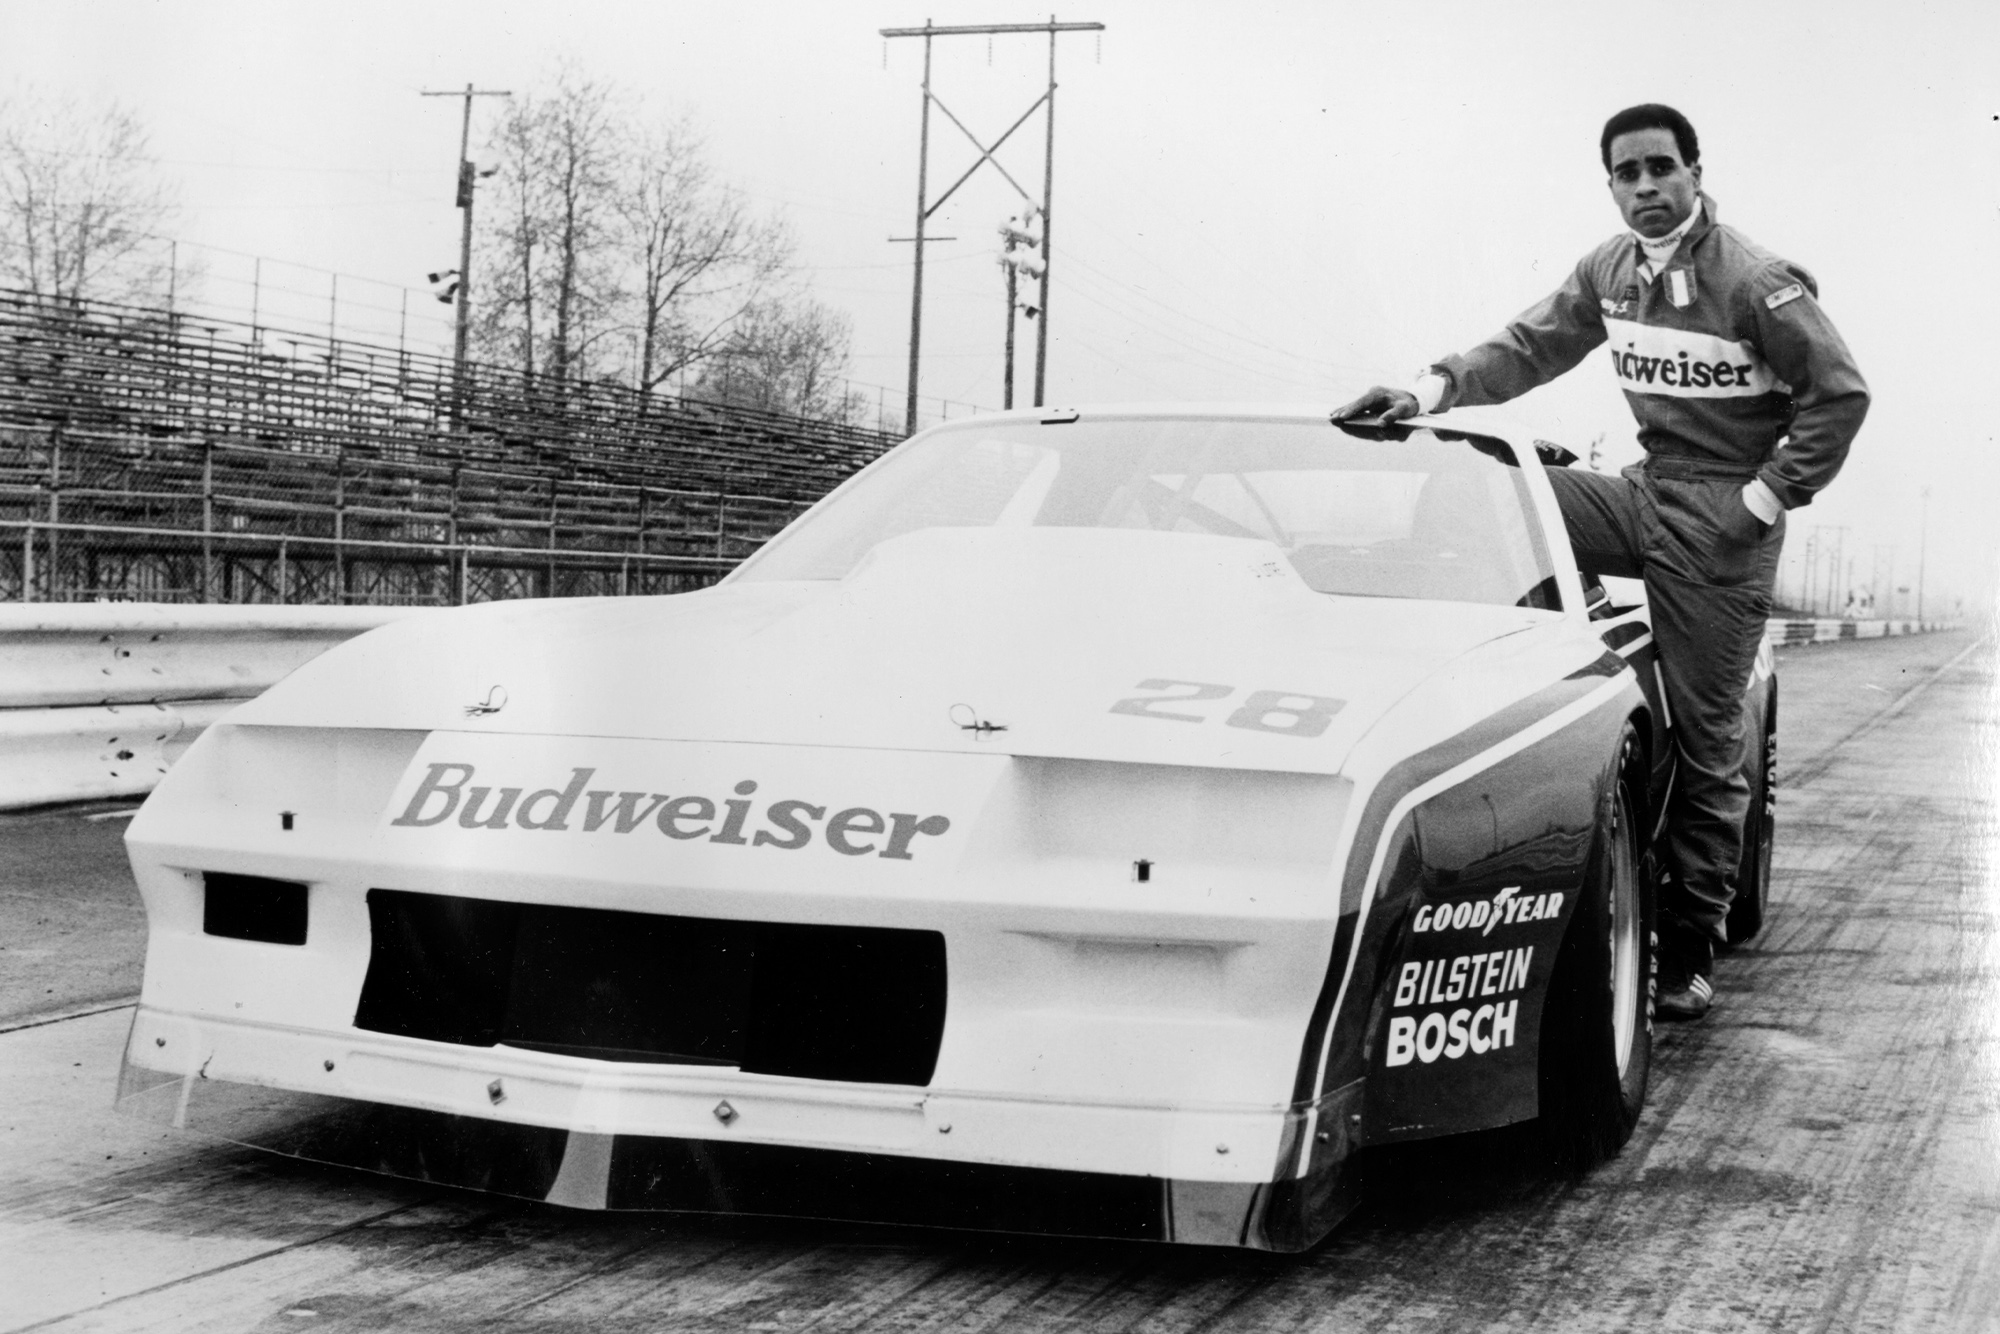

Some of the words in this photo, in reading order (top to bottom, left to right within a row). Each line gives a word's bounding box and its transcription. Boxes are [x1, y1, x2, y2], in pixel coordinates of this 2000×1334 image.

[1612, 342, 1752, 388] dweiser
[1108, 677, 1348, 739] 28
[388, 761, 951, 861] Budweiser
[1412, 886, 1564, 936] GOODYEAR
[1393, 945, 1534, 1008] BILSTEIN
[1385, 999, 1519, 1068] BOSCH
